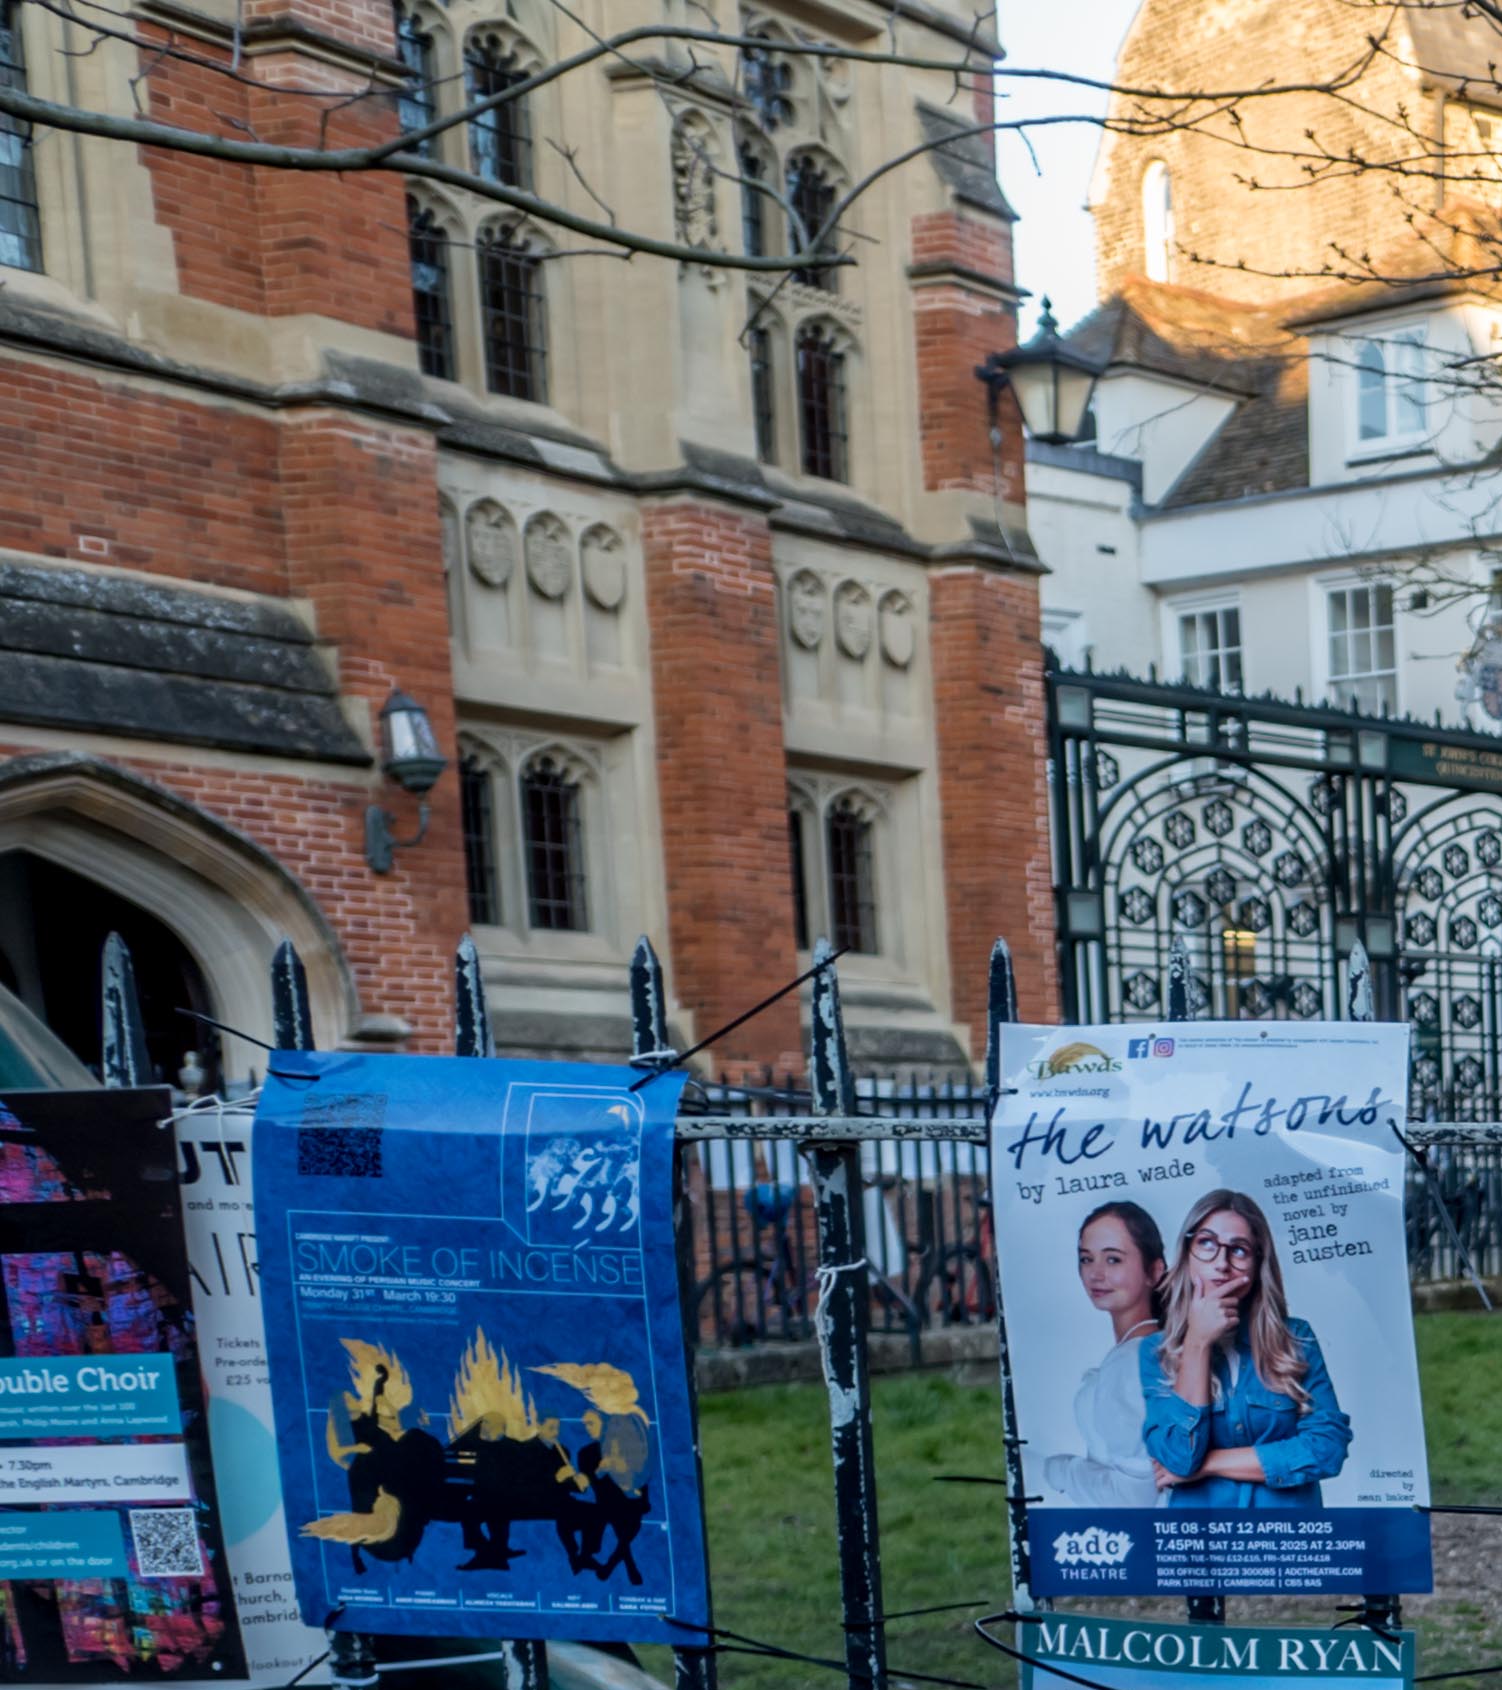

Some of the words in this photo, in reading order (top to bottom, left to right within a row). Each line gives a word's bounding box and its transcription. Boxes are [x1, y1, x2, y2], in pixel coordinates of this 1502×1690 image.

[1027, 1058, 1123, 1081] Bawds
[1008, 1107, 1114, 1169] the
[1142, 1081, 1391, 1149] watsons
[1017, 1182, 1045, 1201] by
[1056, 1169, 1128, 1195] laura
[1138, 1160, 1195, 1182] wade
[1283, 1206, 1325, 1221] novel
[1330, 1202, 1347, 1218] by
[1288, 1223, 1338, 1245] jane
[1292, 1239, 1372, 1264] austen
[298, 1242, 422, 1276] SMOKE
[432, 1247, 479, 1278] OF
[491, 1250, 642, 1285] INCENSE
[314, 1274, 352, 1282] EVENING
[369, 1276, 406, 1284] PERSIAN
[408, 1278, 436, 1286] MUSIC
[300, 1287, 348, 1300] Monday
[383, 1289, 421, 1301] March
[425, 1291, 455, 1303] 19:30
[217, 1339, 260, 1348] Tickets
[77, 1366, 160, 1391] Choir
[9, 1461, 51, 1472] 7.30pm
[1370, 1469, 1413, 1479] directed
[18, 1478, 61, 1489] English
[64, 1476, 110, 1488] Martyrs,
[113, 1475, 179, 1488] Cambridge
[1154, 1523, 1178, 1534] TUE
[1181, 1522, 1198, 1534] 08
[1208, 1523, 1232, 1534] SAT
[1236, 1523, 1253, 1534] 12
[1257, 1523, 1296, 1533] APRIL
[1298, 1523, 1332, 1534] 2025
[1060, 1569, 1127, 1580] THEATRE
[1285, 1568, 1362, 1576] ADCTHEATRE.COM
[1158, 1579, 1178, 1587] PARK
[1181, 1579, 1214, 1587] STREET
[1224, 1579, 1276, 1587] CAMBRIDGE
[1036, 1623, 1259, 1670] MALCOLM
[1278, 1637, 1404, 1672] RYAN
